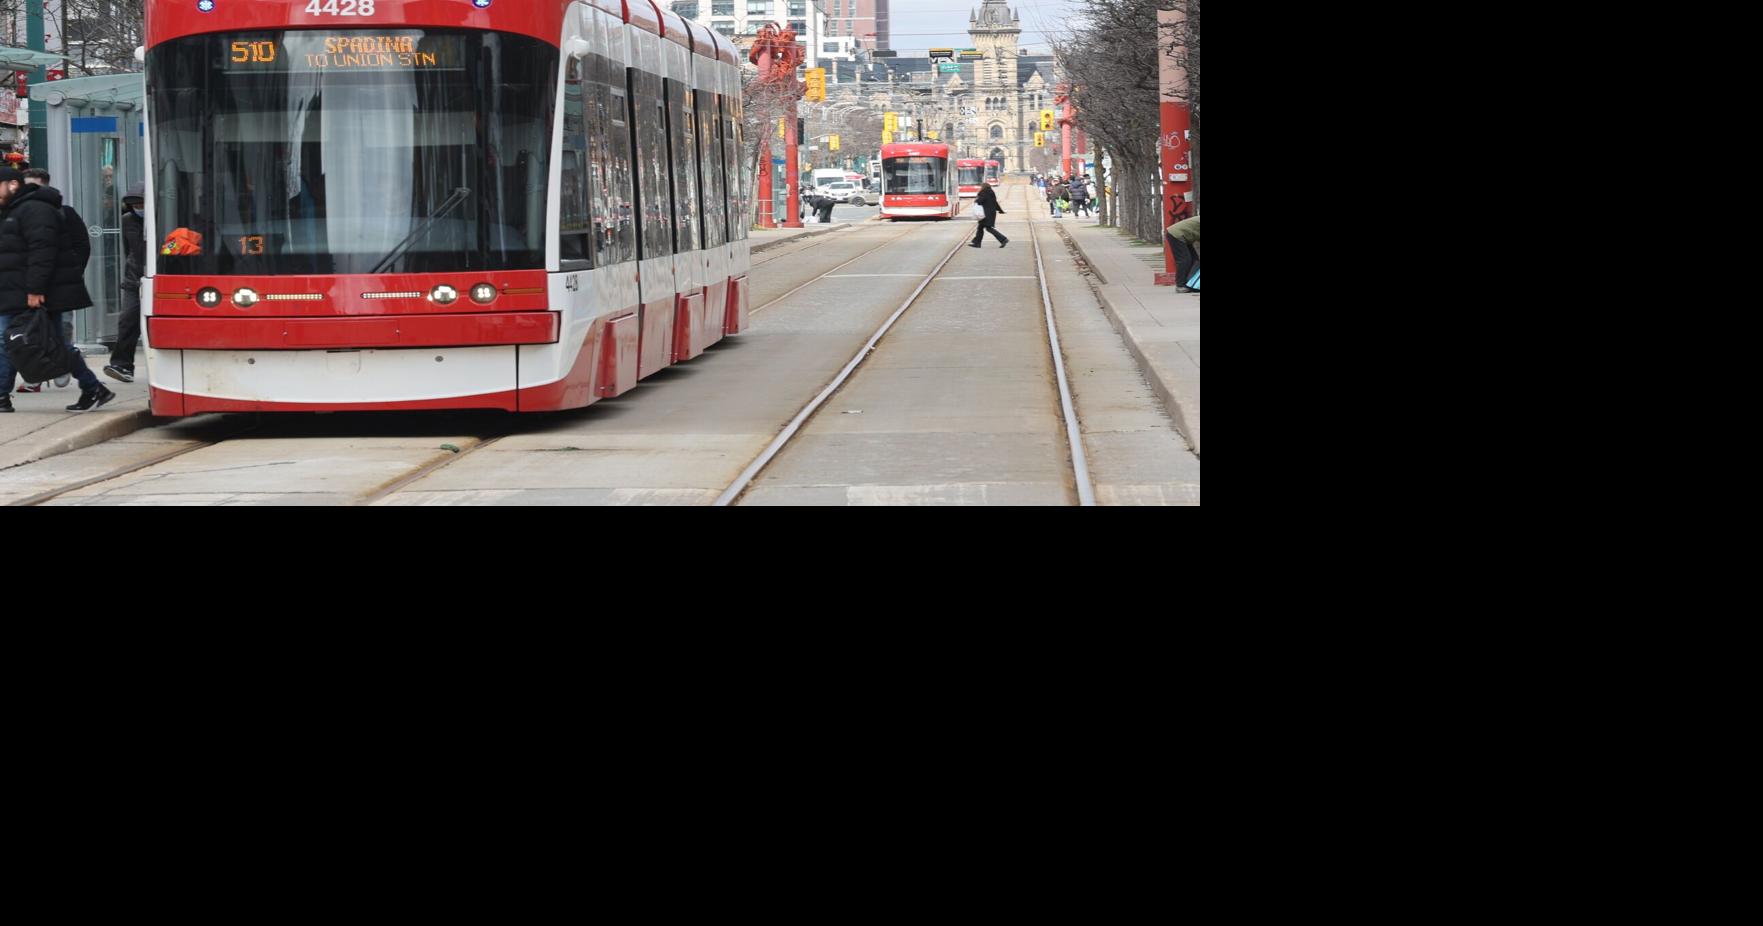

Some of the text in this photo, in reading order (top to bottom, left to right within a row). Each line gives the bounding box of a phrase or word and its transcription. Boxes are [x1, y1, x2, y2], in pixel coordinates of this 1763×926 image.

[305, 0, 375, 17] 4428
[231, 41, 275, 63] 510
[324, 36, 413, 54] SPADINA
[304, 52, 436, 68] TO UNION STN
[239, 236, 264, 256] 13
